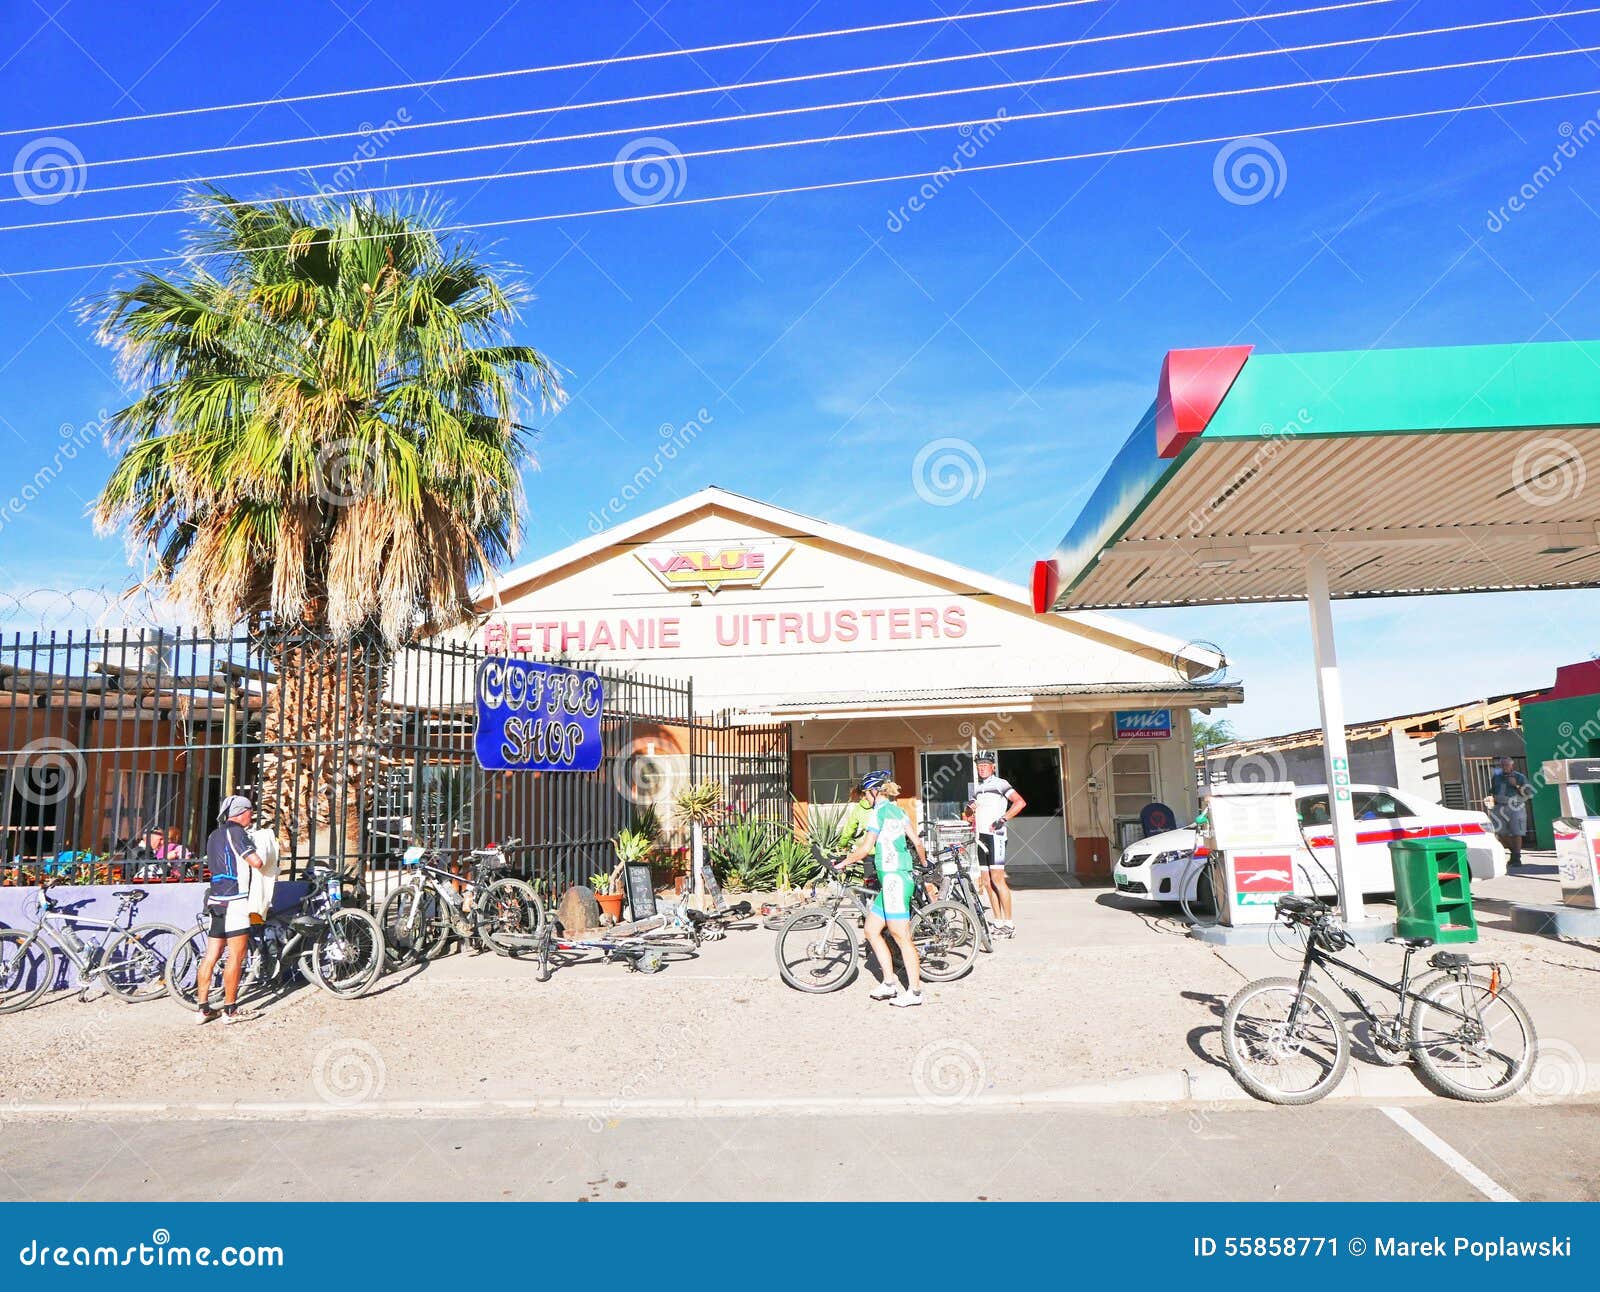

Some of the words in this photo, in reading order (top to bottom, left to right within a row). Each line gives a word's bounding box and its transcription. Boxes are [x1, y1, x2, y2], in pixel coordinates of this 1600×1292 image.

[648, 552, 765, 572] VALUE
[484, 617, 681, 654] BETHANIE
[716, 605, 967, 646] UITRUSTERS
[481, 662, 600, 718] COFFEE
[501, 716, 584, 765] SHOP
